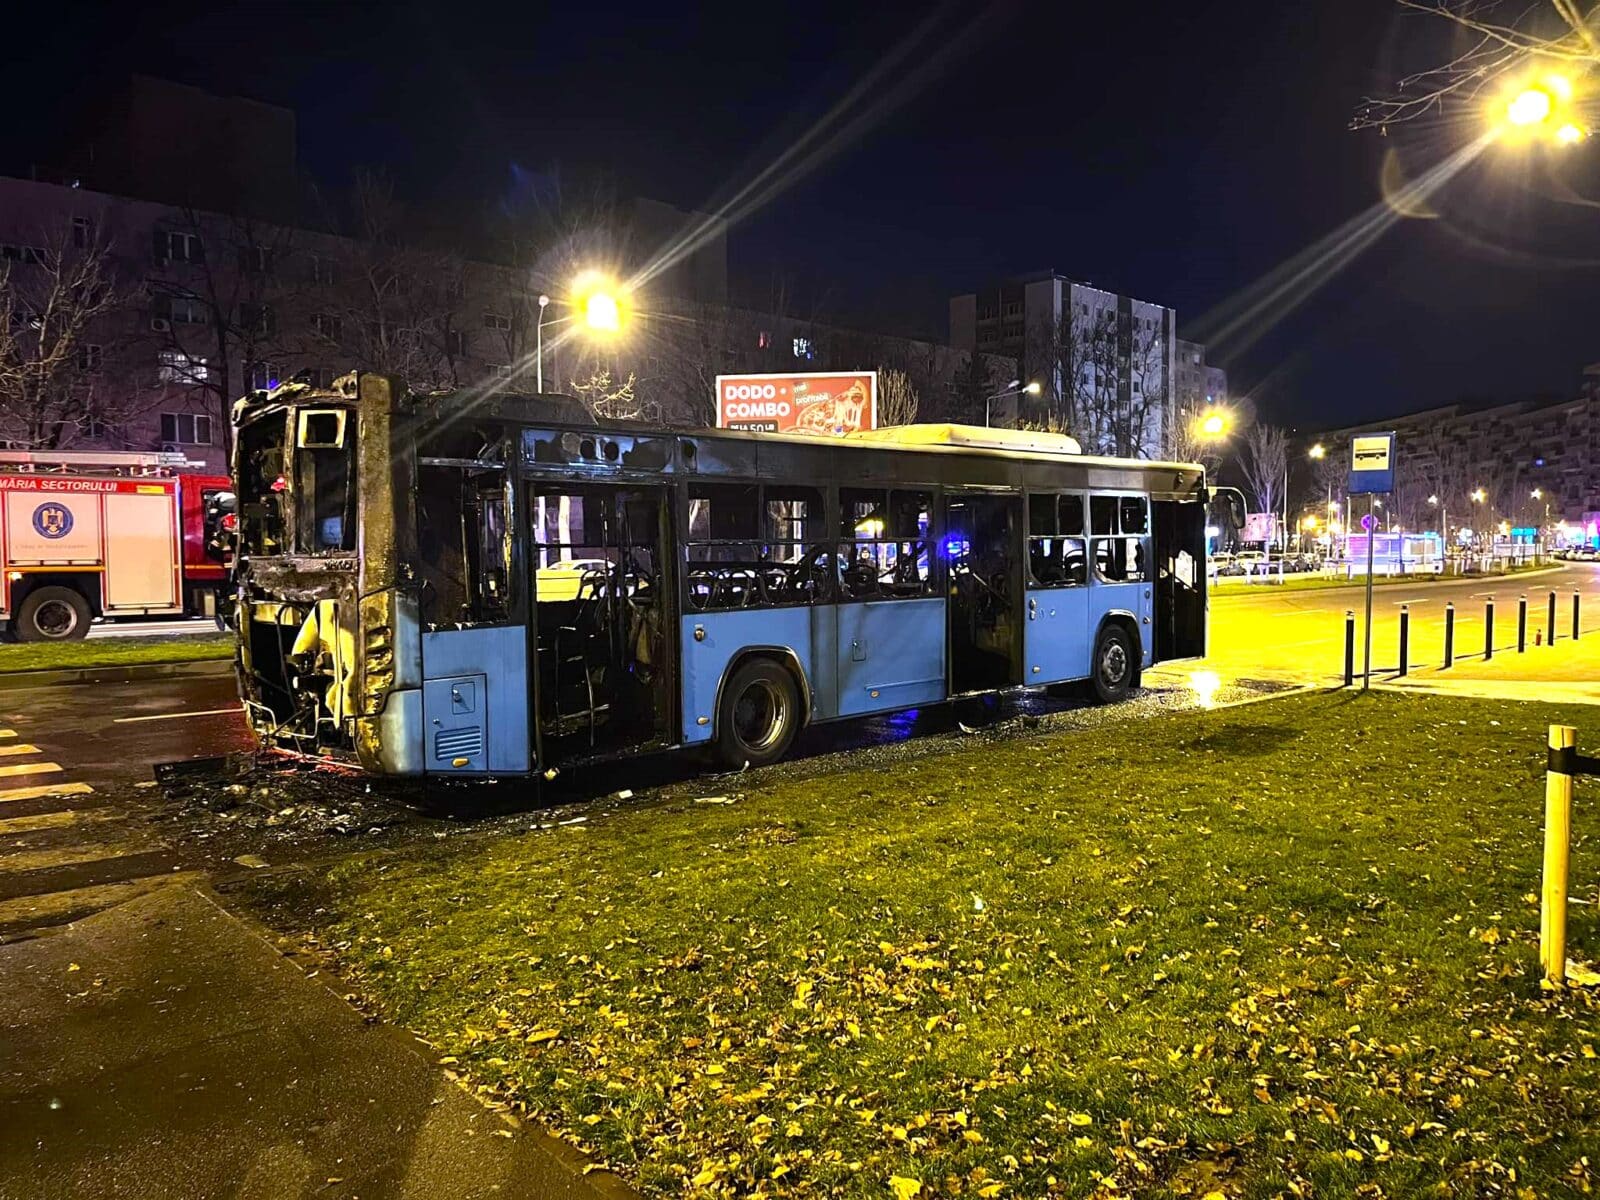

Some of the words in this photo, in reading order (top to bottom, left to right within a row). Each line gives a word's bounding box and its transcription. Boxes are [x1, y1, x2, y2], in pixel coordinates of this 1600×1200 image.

[725, 385, 776, 400] DODO
[725, 402, 791, 417] COMBO
[41, 480, 118, 491] SECTORULUI
